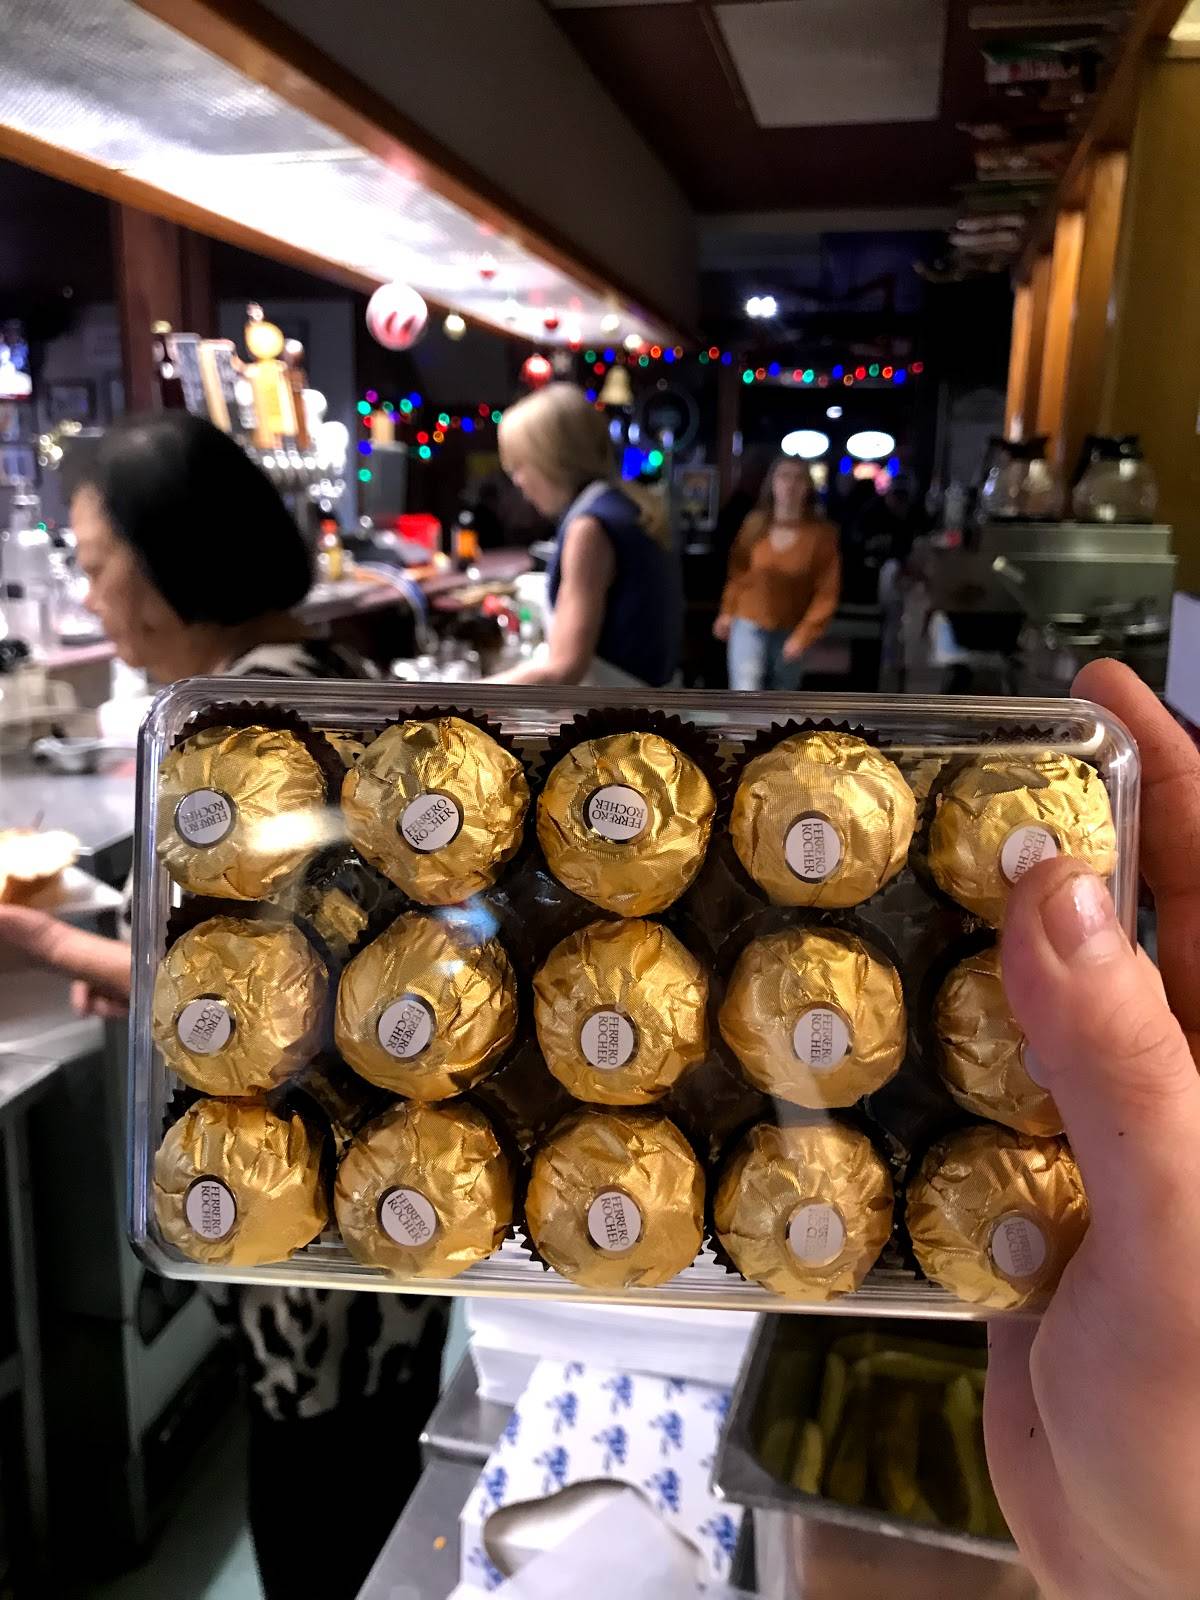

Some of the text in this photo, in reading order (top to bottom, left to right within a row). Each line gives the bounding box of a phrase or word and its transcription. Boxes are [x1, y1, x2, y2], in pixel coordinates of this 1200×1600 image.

[184, 811, 228, 834] FERRERO
[405, 799, 447, 837] FERRERO
[412, 807, 455, 845] ROCHER
[592, 810, 642, 829] FERRERO
[596, 799, 644, 817] ROCHER
[802, 823, 815, 874] ROCHER
[813, 823, 826, 873] FERRERO
[386, 1004, 415, 1049] ROCHER
[396, 1007, 424, 1055] FERRERO
[597, 1015, 609, 1064] ROCHER
[608, 1016, 619, 1065] FERRERO
[811, 1014, 822, 1063] ROCHER
[821, 1014, 832, 1064] FERRERO
[201, 1185, 211, 1234] ROCHER
[211, 1186, 221, 1235] FERRERO
[388, 1199, 421, 1242] ROCHER
[396, 1192, 430, 1237] FERRERO
[602, 1197, 619, 1248] ROCHER
[611, 1195, 630, 1246] FERRERO
